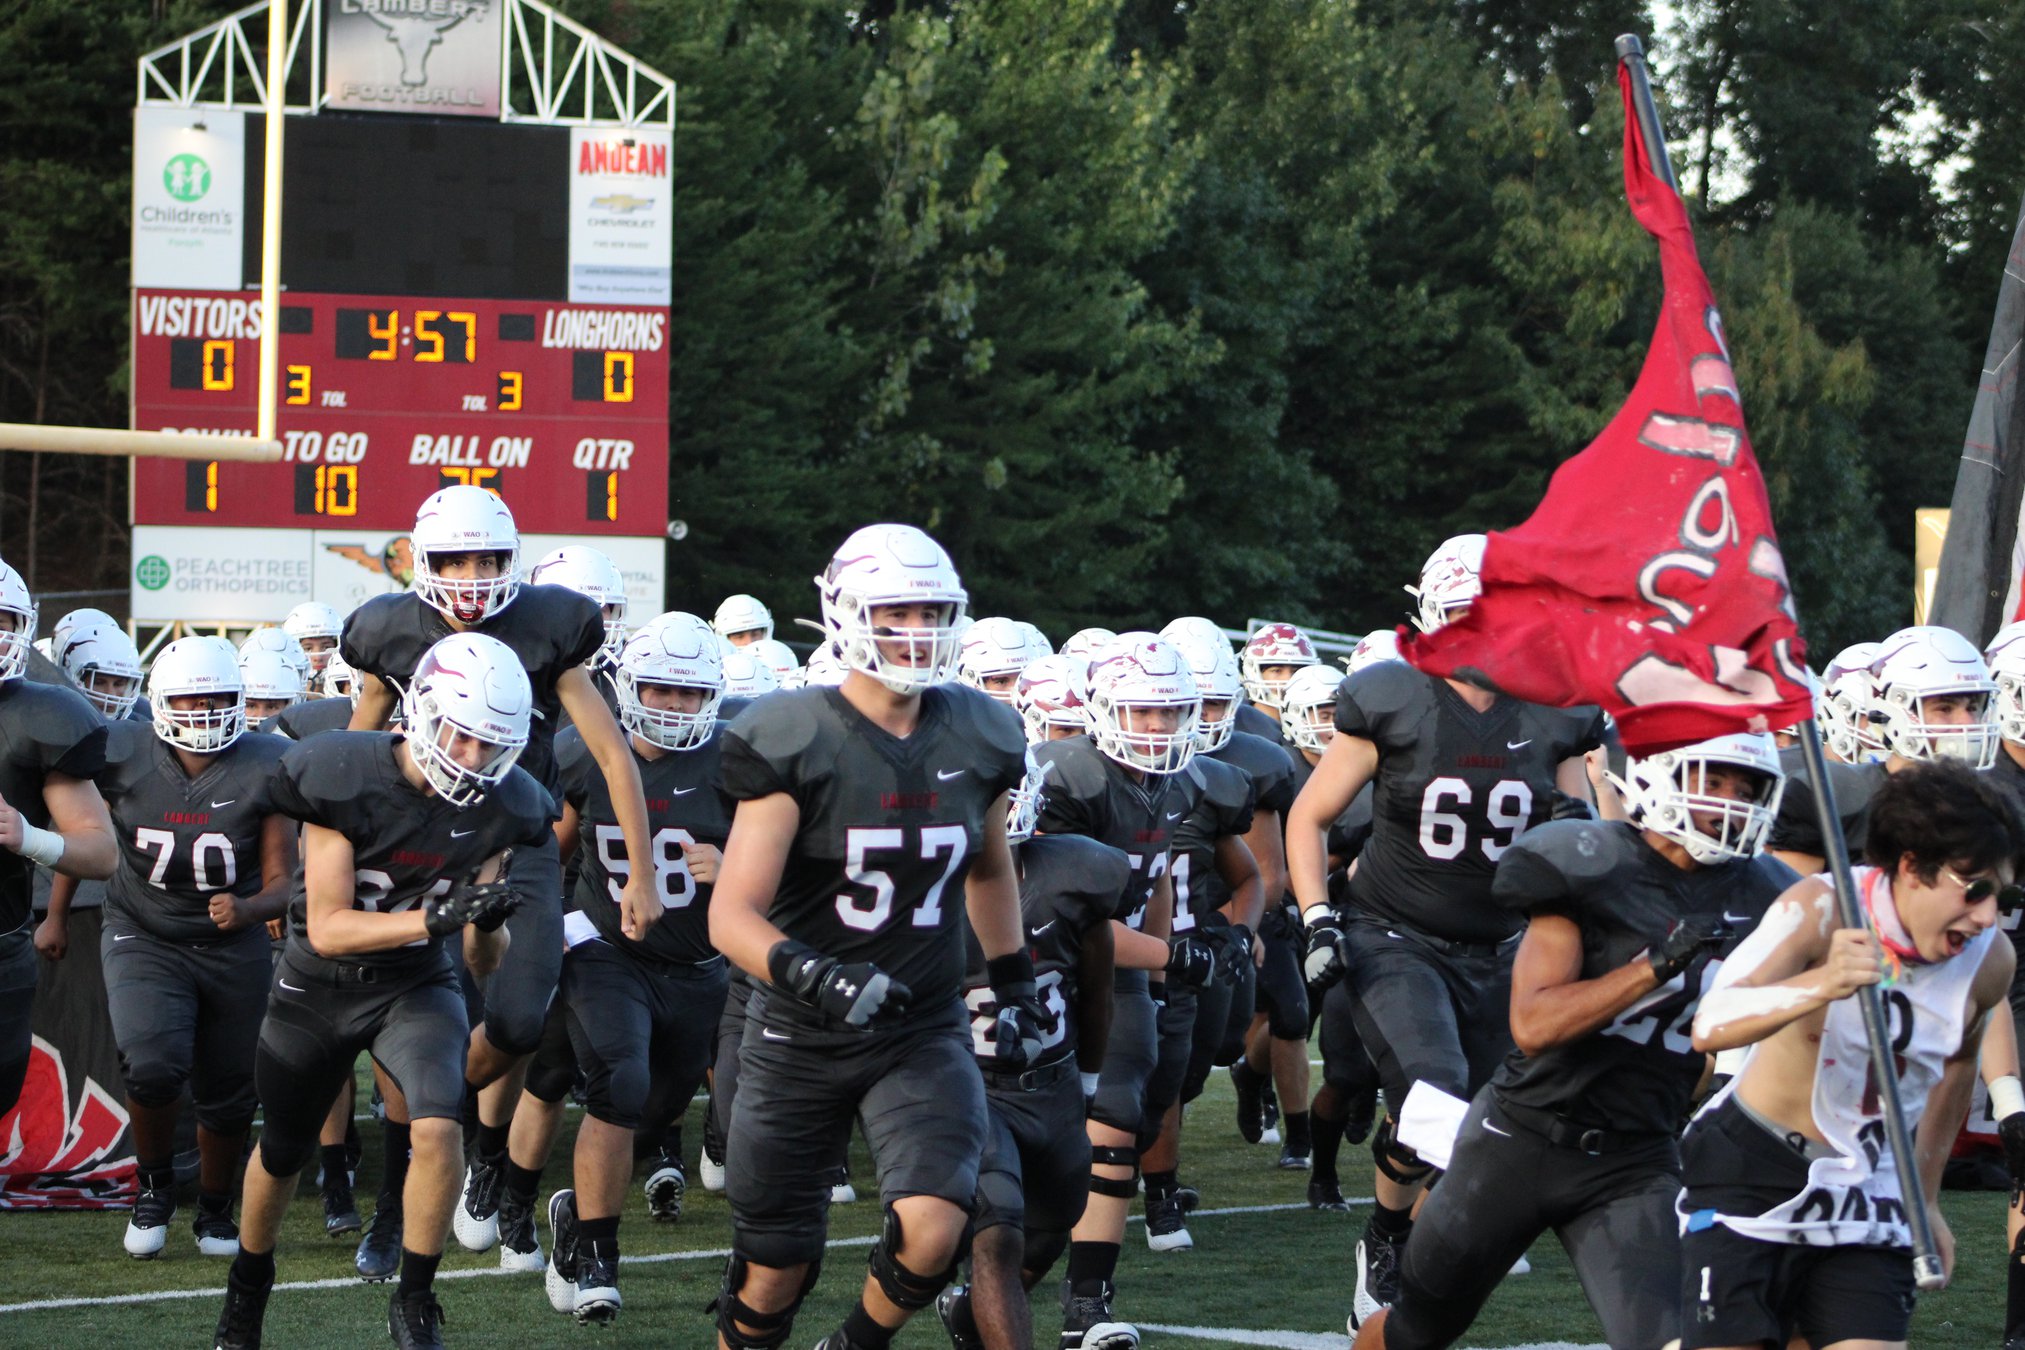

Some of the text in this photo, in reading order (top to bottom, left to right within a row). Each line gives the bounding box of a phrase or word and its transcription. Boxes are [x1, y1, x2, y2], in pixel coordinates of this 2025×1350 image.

[341, 0, 489, 22] LAMBERT
[341, 83, 485, 107] FOOTBALL
[579, 139, 667, 178] ANDEAN
[140, 205, 233, 225] Children's
[139, 296, 262, 339] VISITORS
[541, 309, 666, 351] LONGHORNS
[202, 339, 235, 391] 0
[286, 364, 311, 405] 3
[603, 351, 634, 402] 0
[321, 391, 347, 407] TOL
[462, 395, 488, 411] TOL
[498, 371, 522, 411] 3
[284, 431, 368, 463] TO GO
[408, 434, 533, 468] BALL ON
[573, 438, 634, 470] QTR
[206, 461, 218, 512] 1
[314, 464, 358, 516] 10
[606, 471, 618, 521] 1
[175, 557, 309, 578] PEACHTREE
[175, 578, 309, 595] ORTHOPEDICS
[489, 723, 507, 734] WAO
[1418, 776, 1534, 862] 69
[135, 826, 237, 892] 70
[594, 823, 698, 910] 58
[834, 823, 969, 932] 57
[1699, 1266, 1711, 1301] 1
